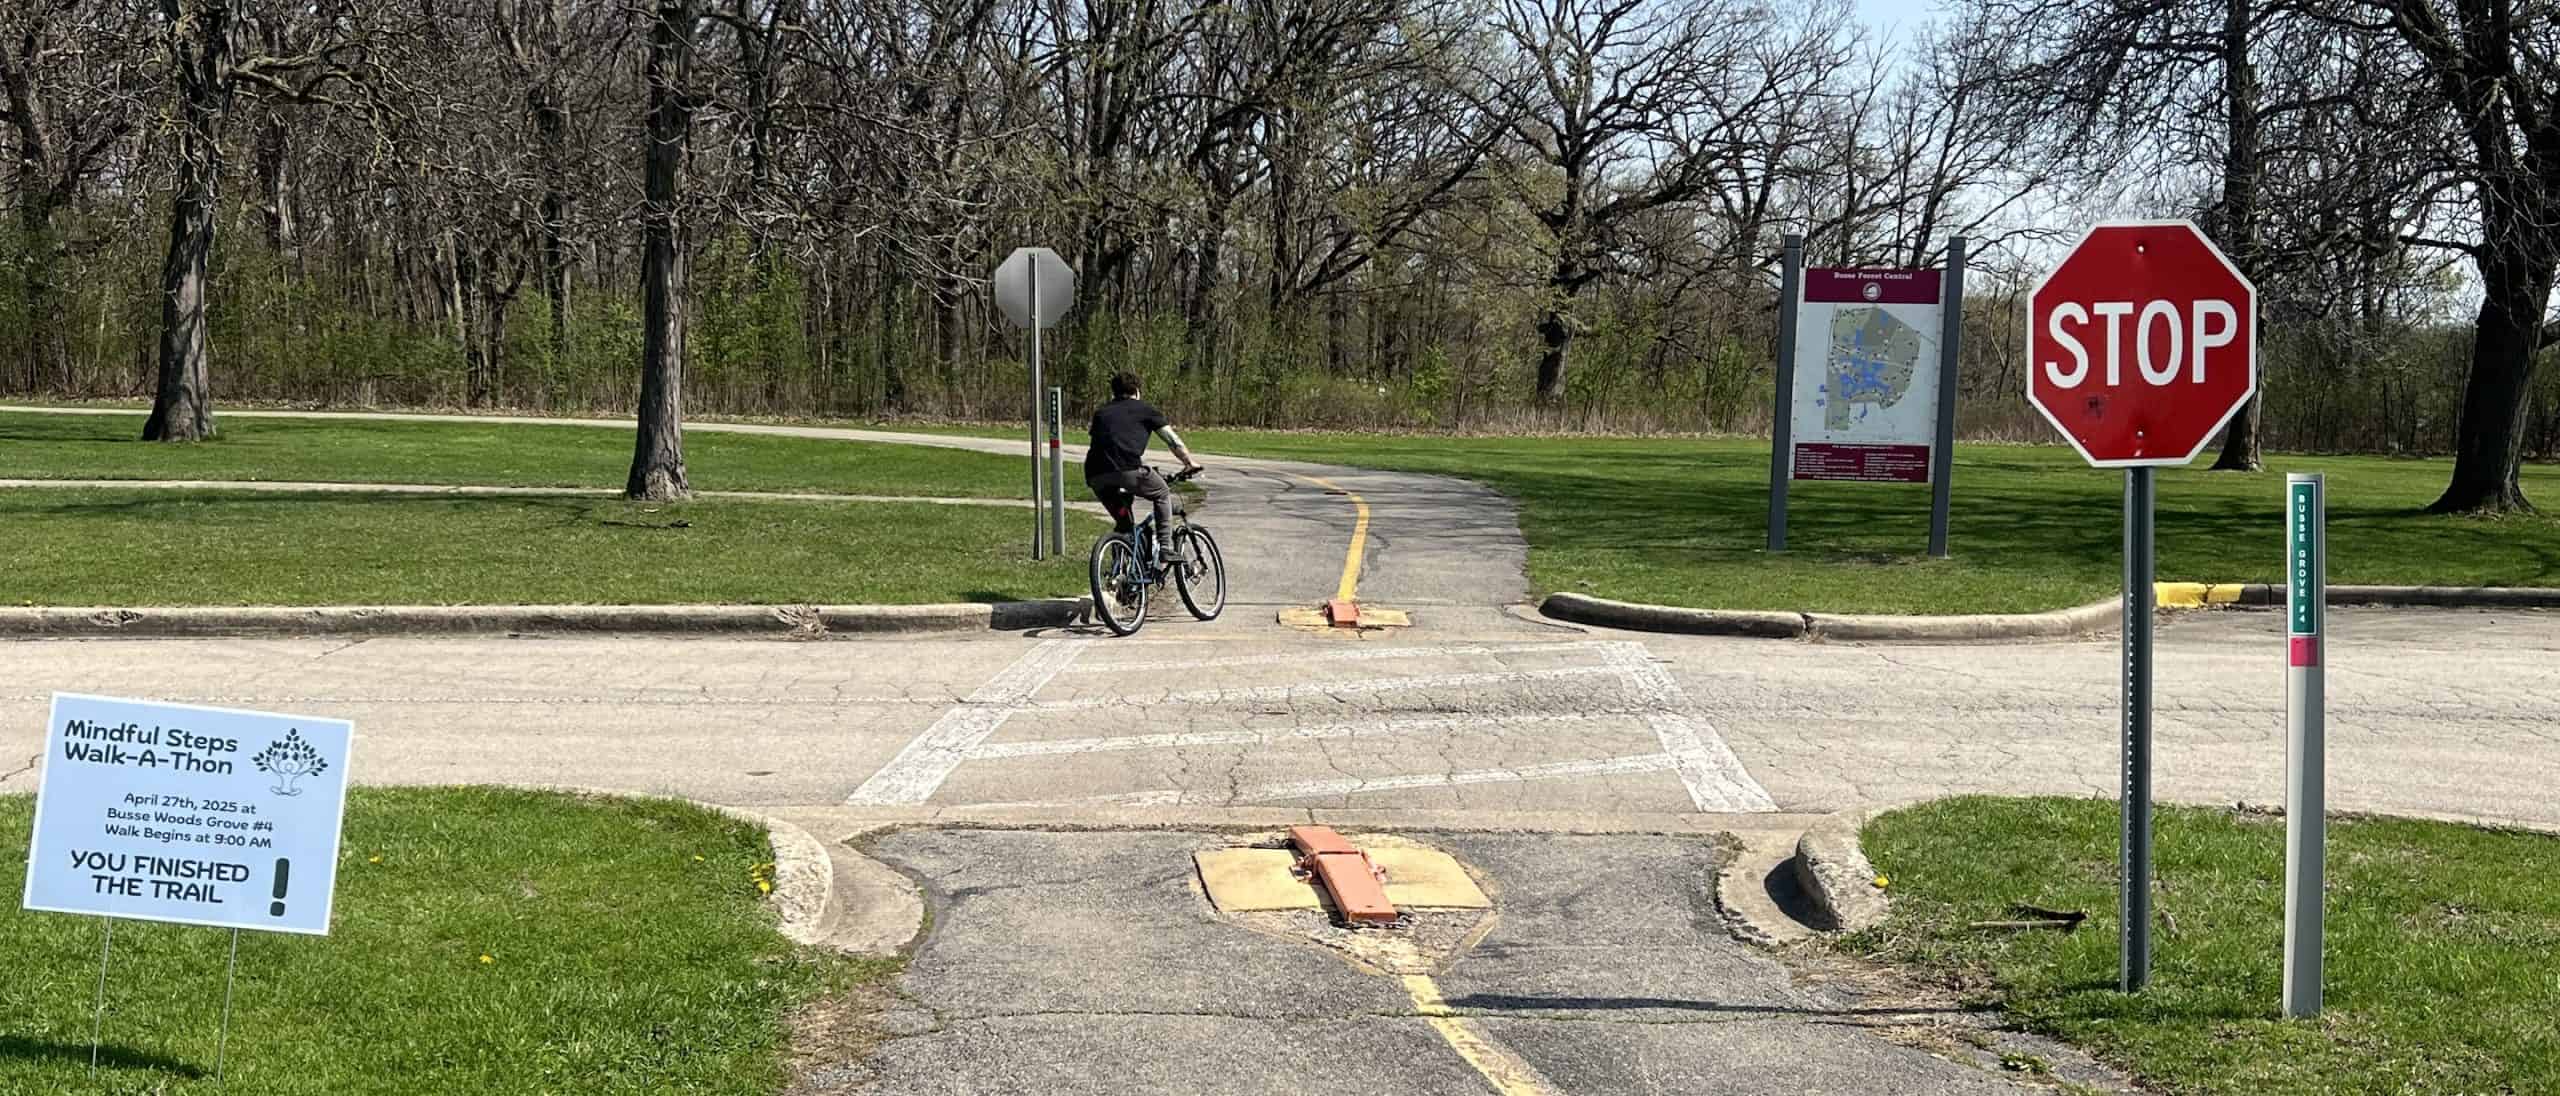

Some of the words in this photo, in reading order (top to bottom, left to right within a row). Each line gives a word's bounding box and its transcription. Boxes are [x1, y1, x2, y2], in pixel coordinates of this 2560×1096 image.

[1883, 272, 1913, 280] Central
[2045, 299, 2238, 389] STOP
[2298, 494, 2306, 542] BUSSE
[2298, 550, 2307, 597] GROVE
[2298, 604, 2306, 623] #4
[64, 719, 160, 745] Mindful
[165, 729, 238, 756] Steps
[64, 741, 233, 775] Walk-A-Thon
[124, 793, 158, 807] April
[161, 796, 198, 810] 27th,
[201, 800, 238, 812] 2025
[241, 804, 257, 814] at
[107, 808, 151, 822] Busse
[154, 811, 202, 826] Woods
[206, 816, 249, 830] Grove
[252, 821, 273, 832] #4
[105, 824, 140, 837] Walk
[143, 827, 191, 843] Begins
[194, 833, 211, 843] at
[214, 834, 246, 847] 9:00
[249, 837, 272, 849] AM
[71, 850, 126, 872] YOU
[133, 855, 250, 882] FINISHED
[91, 874, 143, 897] THE
[150, 879, 223, 903] TRAIL
